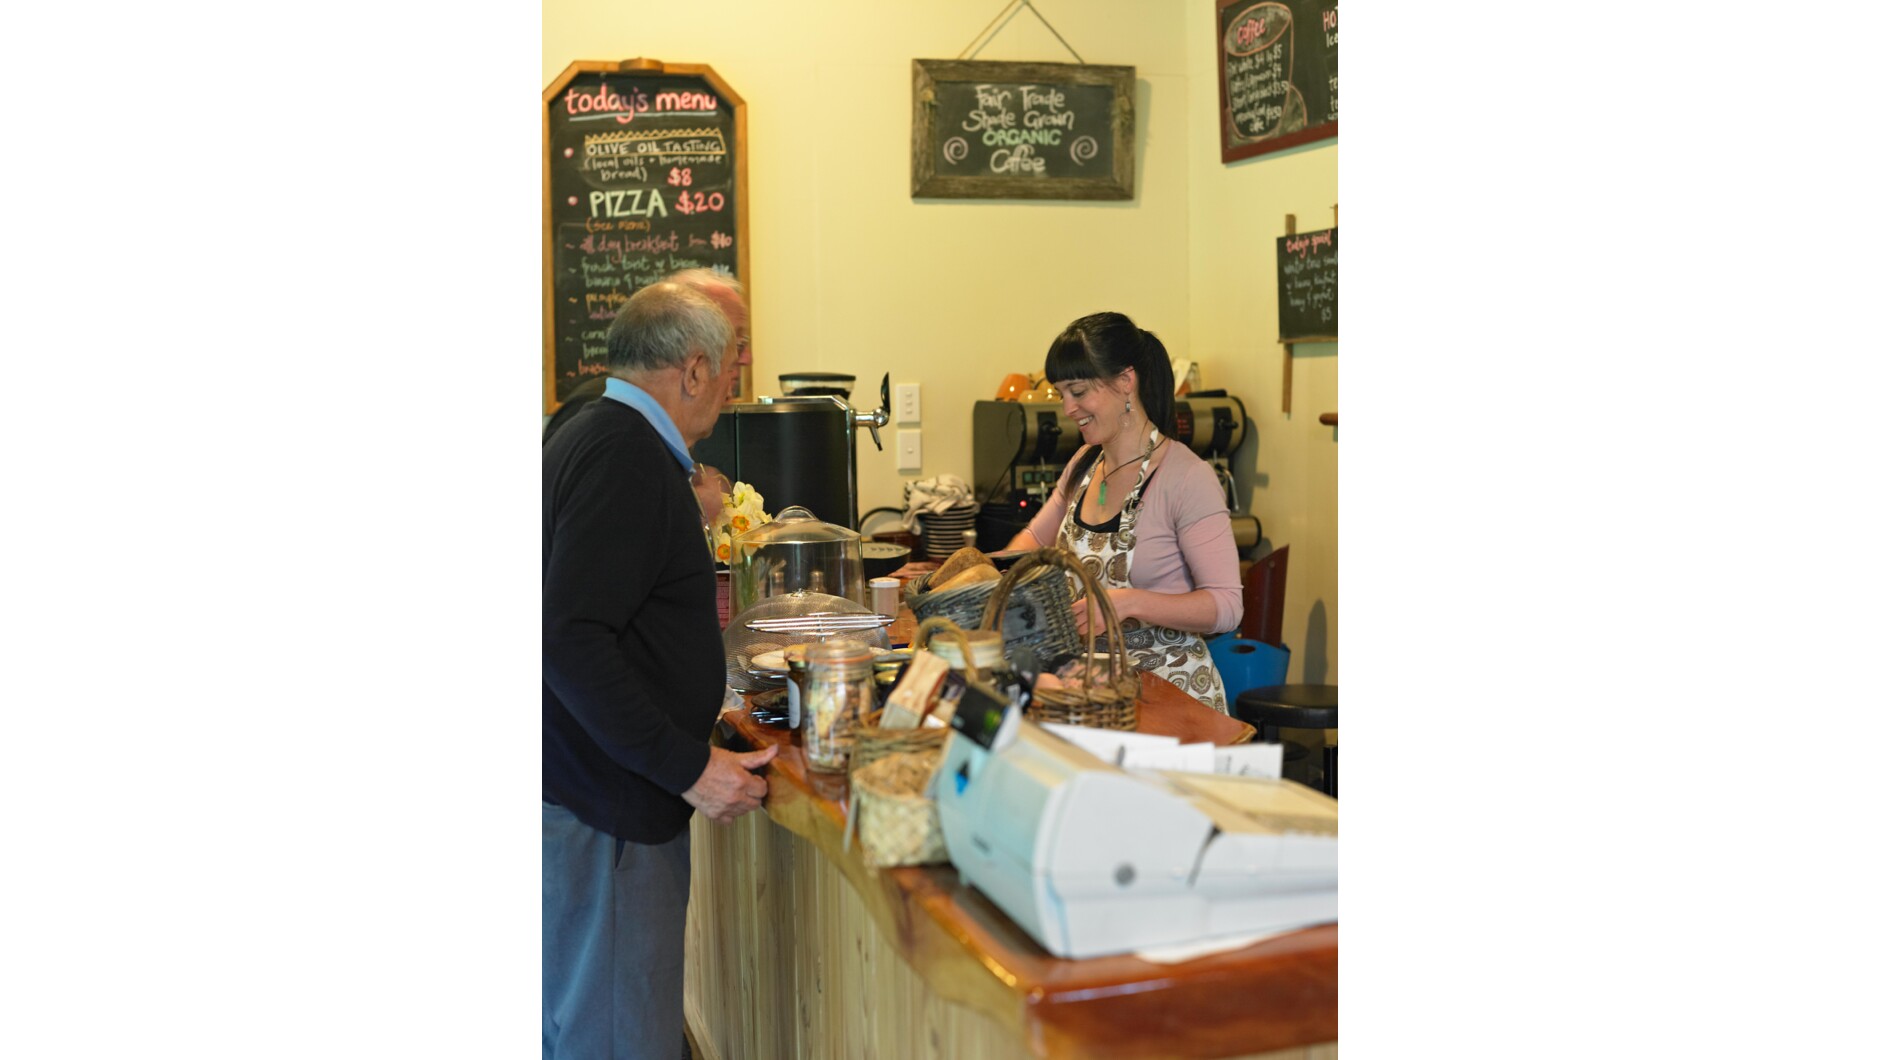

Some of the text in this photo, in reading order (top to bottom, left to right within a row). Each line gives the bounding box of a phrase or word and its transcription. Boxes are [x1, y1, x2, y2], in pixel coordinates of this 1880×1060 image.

[565, 84, 717, 124] today's menu
[975, 84, 1065, 111] Fair Trade
[962, 109, 1074, 131] Shade Grown
[586, 140, 720, 155] OLIVE OIL TASTING
[982, 129, 1062, 147] ORGANIC
[990, 144, 1046, 174] Coffee
[667, 167, 692, 186] $8
[589, 189, 724, 217] PIZZA $20
